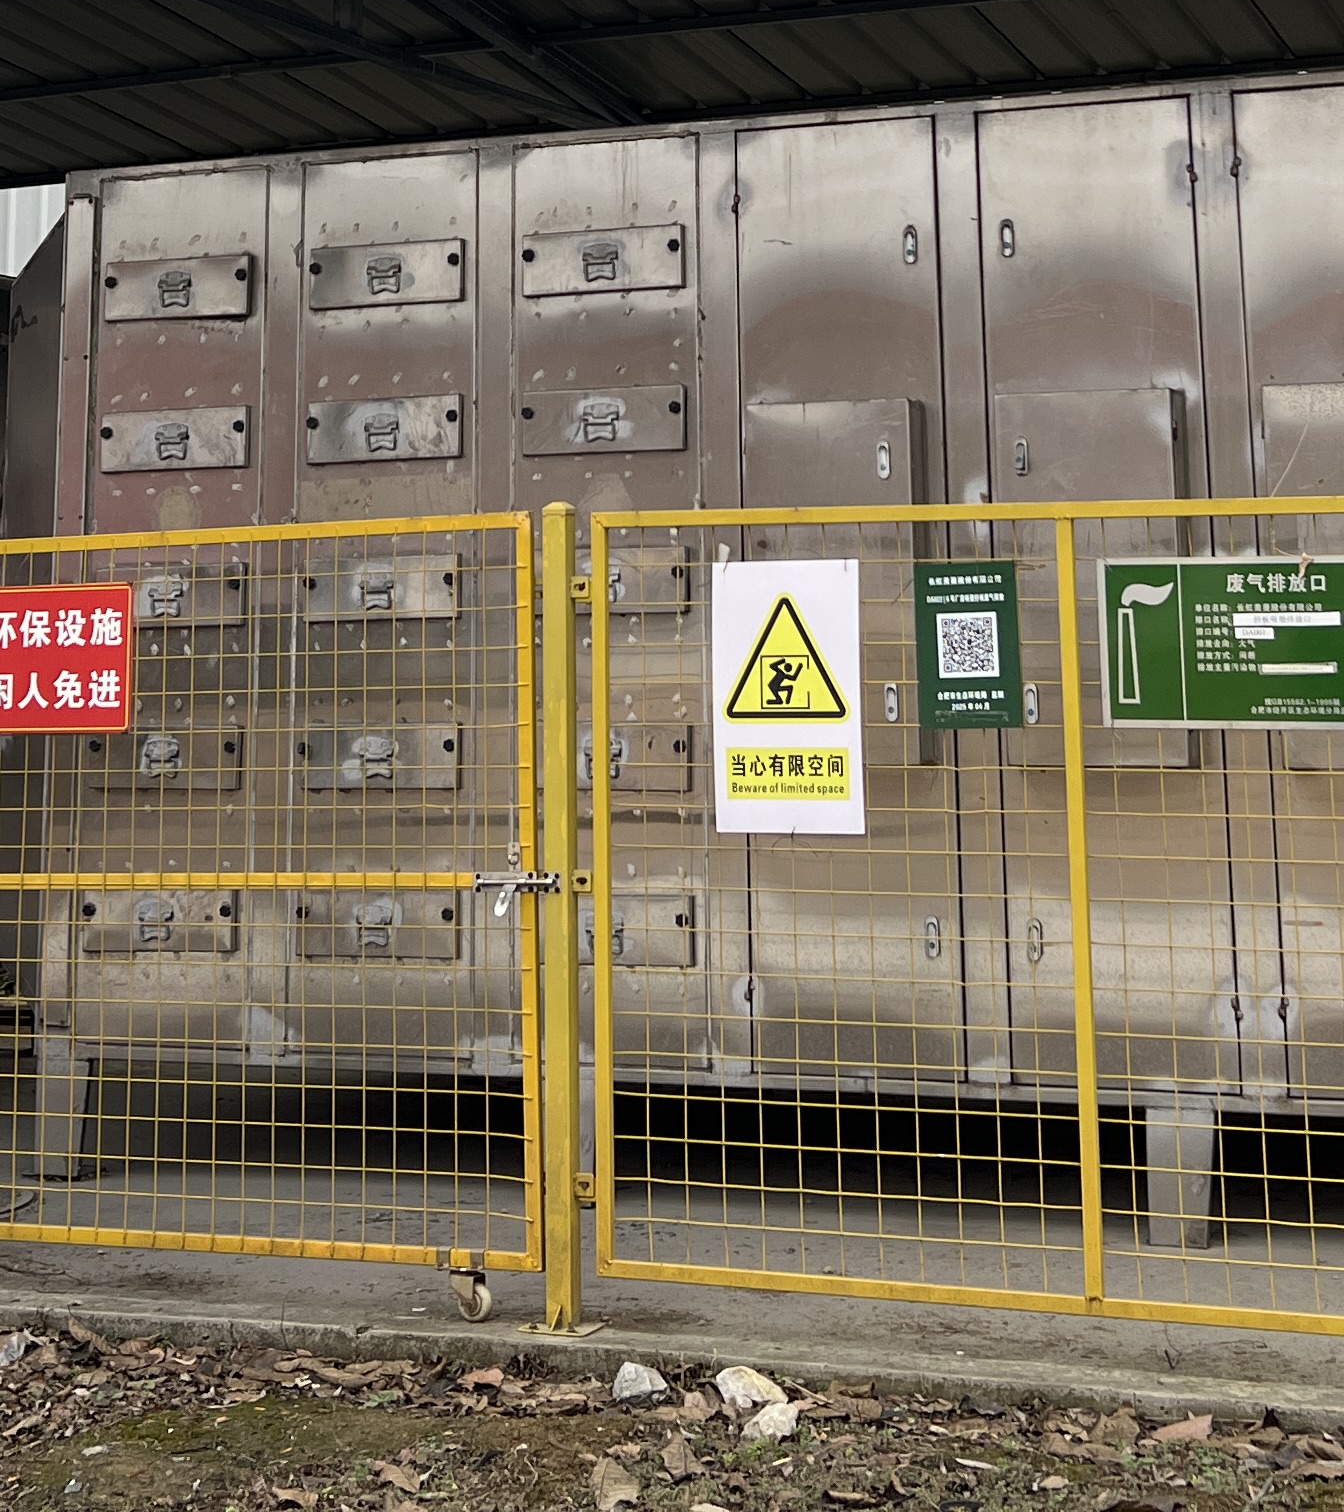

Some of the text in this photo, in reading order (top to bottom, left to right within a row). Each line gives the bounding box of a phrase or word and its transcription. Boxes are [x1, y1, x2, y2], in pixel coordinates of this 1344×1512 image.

[1226, 573, 1327, 593] 废气排放口
[731, 753, 844, 777] 当心有限空间
[732, 782, 845, 796] Beware of limited space
